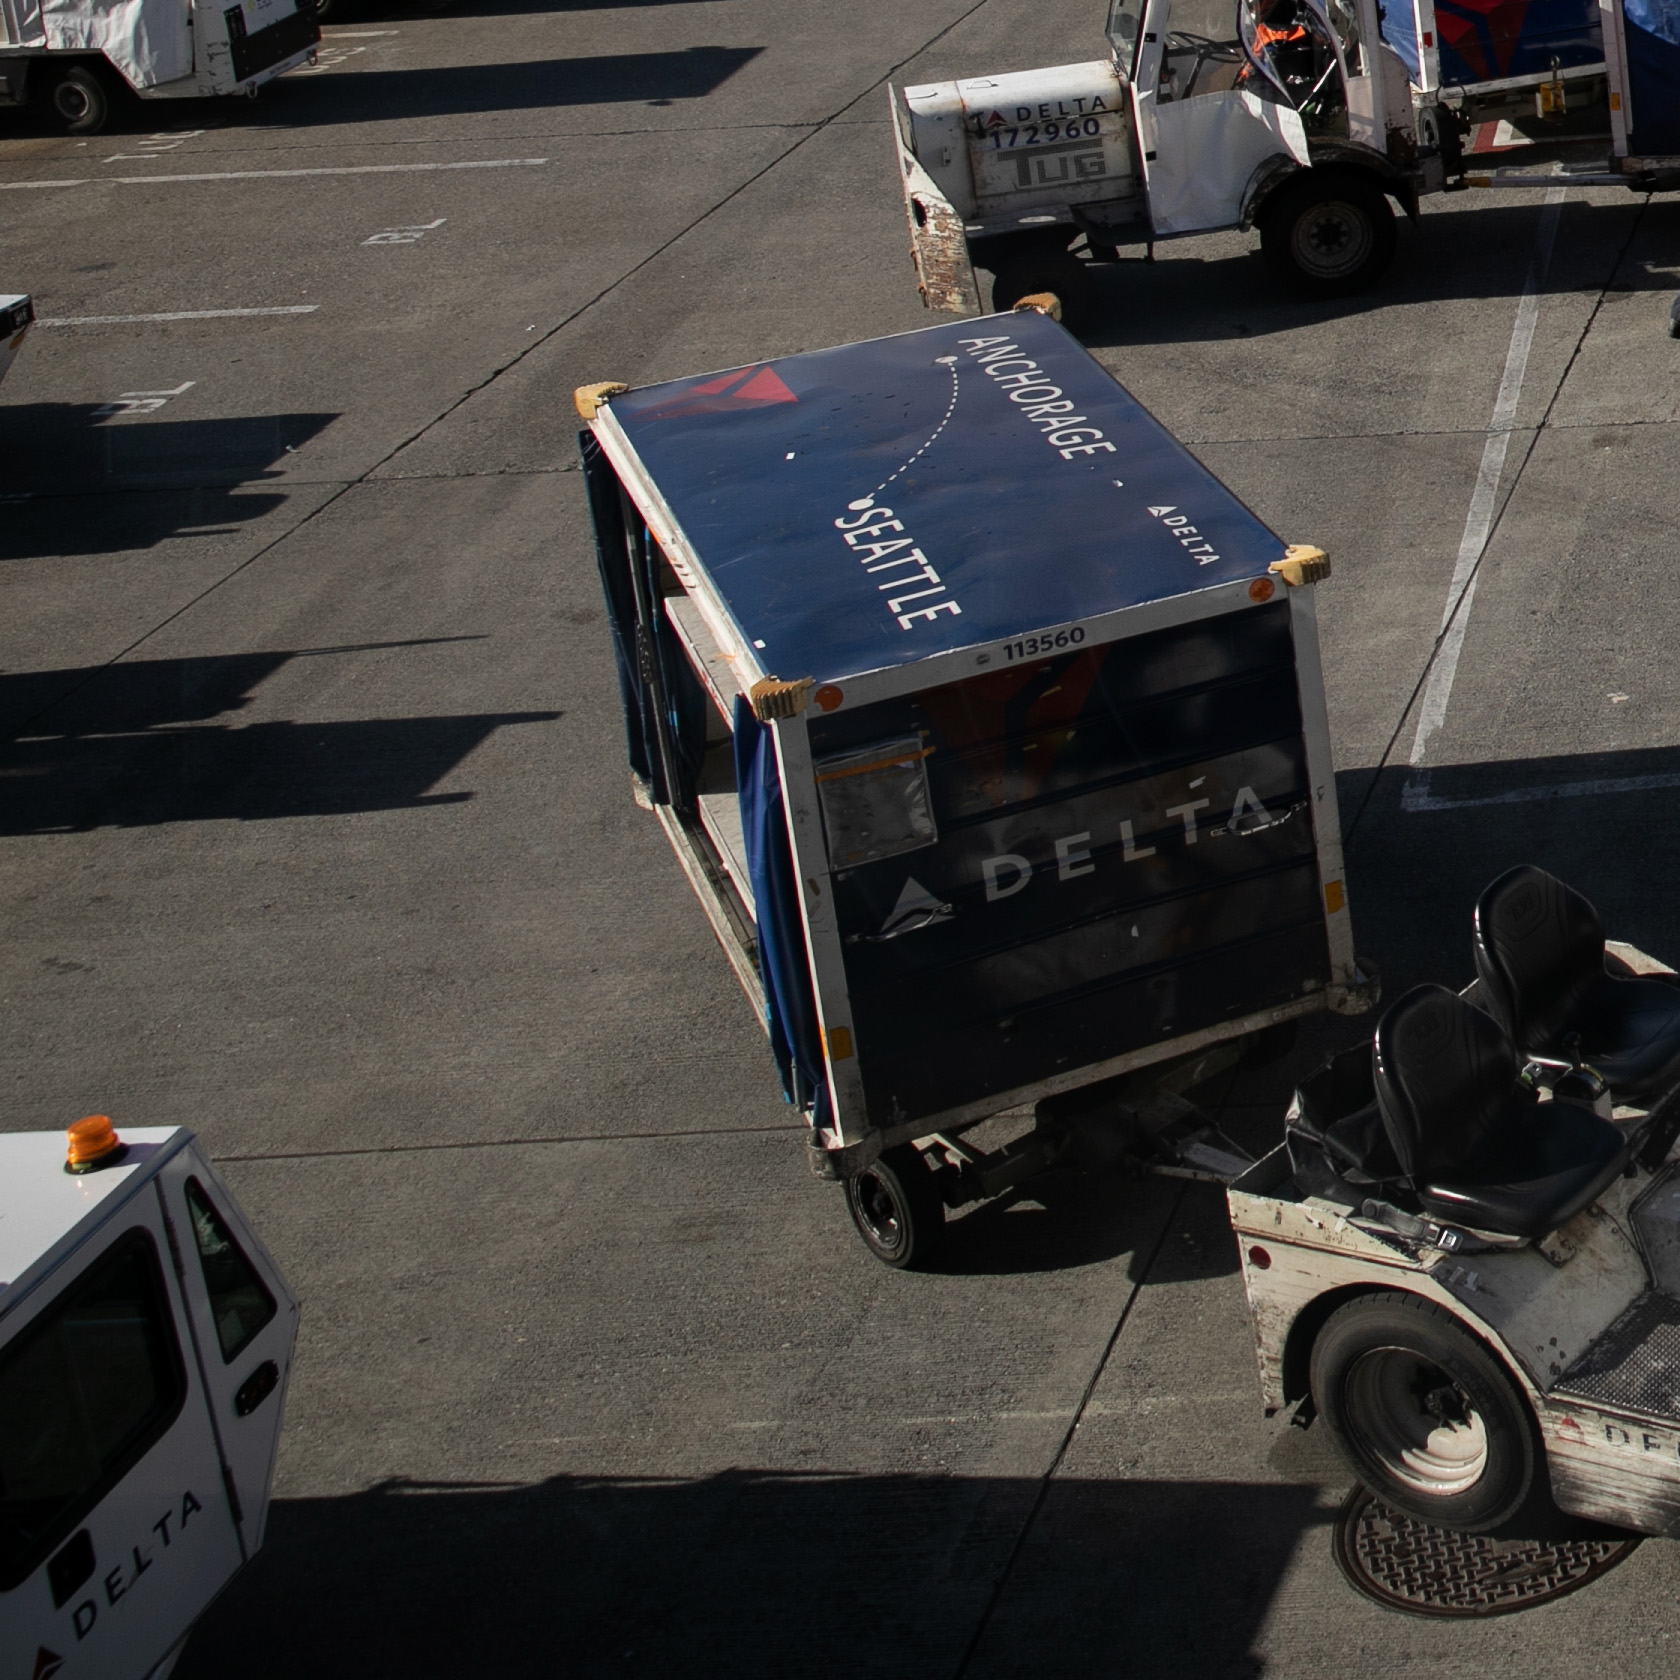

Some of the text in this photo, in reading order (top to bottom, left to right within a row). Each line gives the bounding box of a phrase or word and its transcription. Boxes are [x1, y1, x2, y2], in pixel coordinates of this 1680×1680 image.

[988, 117, 1101, 150] 172960
[1016, 95, 1108, 123] DELTA
[996, 138, 1107, 188] TUG
[957, 335, 1117, 460] ANCHORAGE
[1163, 515, 1221, 566] DELTA
[834, 505, 963, 631] SEATTLE
[1003, 626, 1086, 661] 113560
[981, 785, 1274, 902] DELTA
[71, 1489, 203, 1643] DELTA
